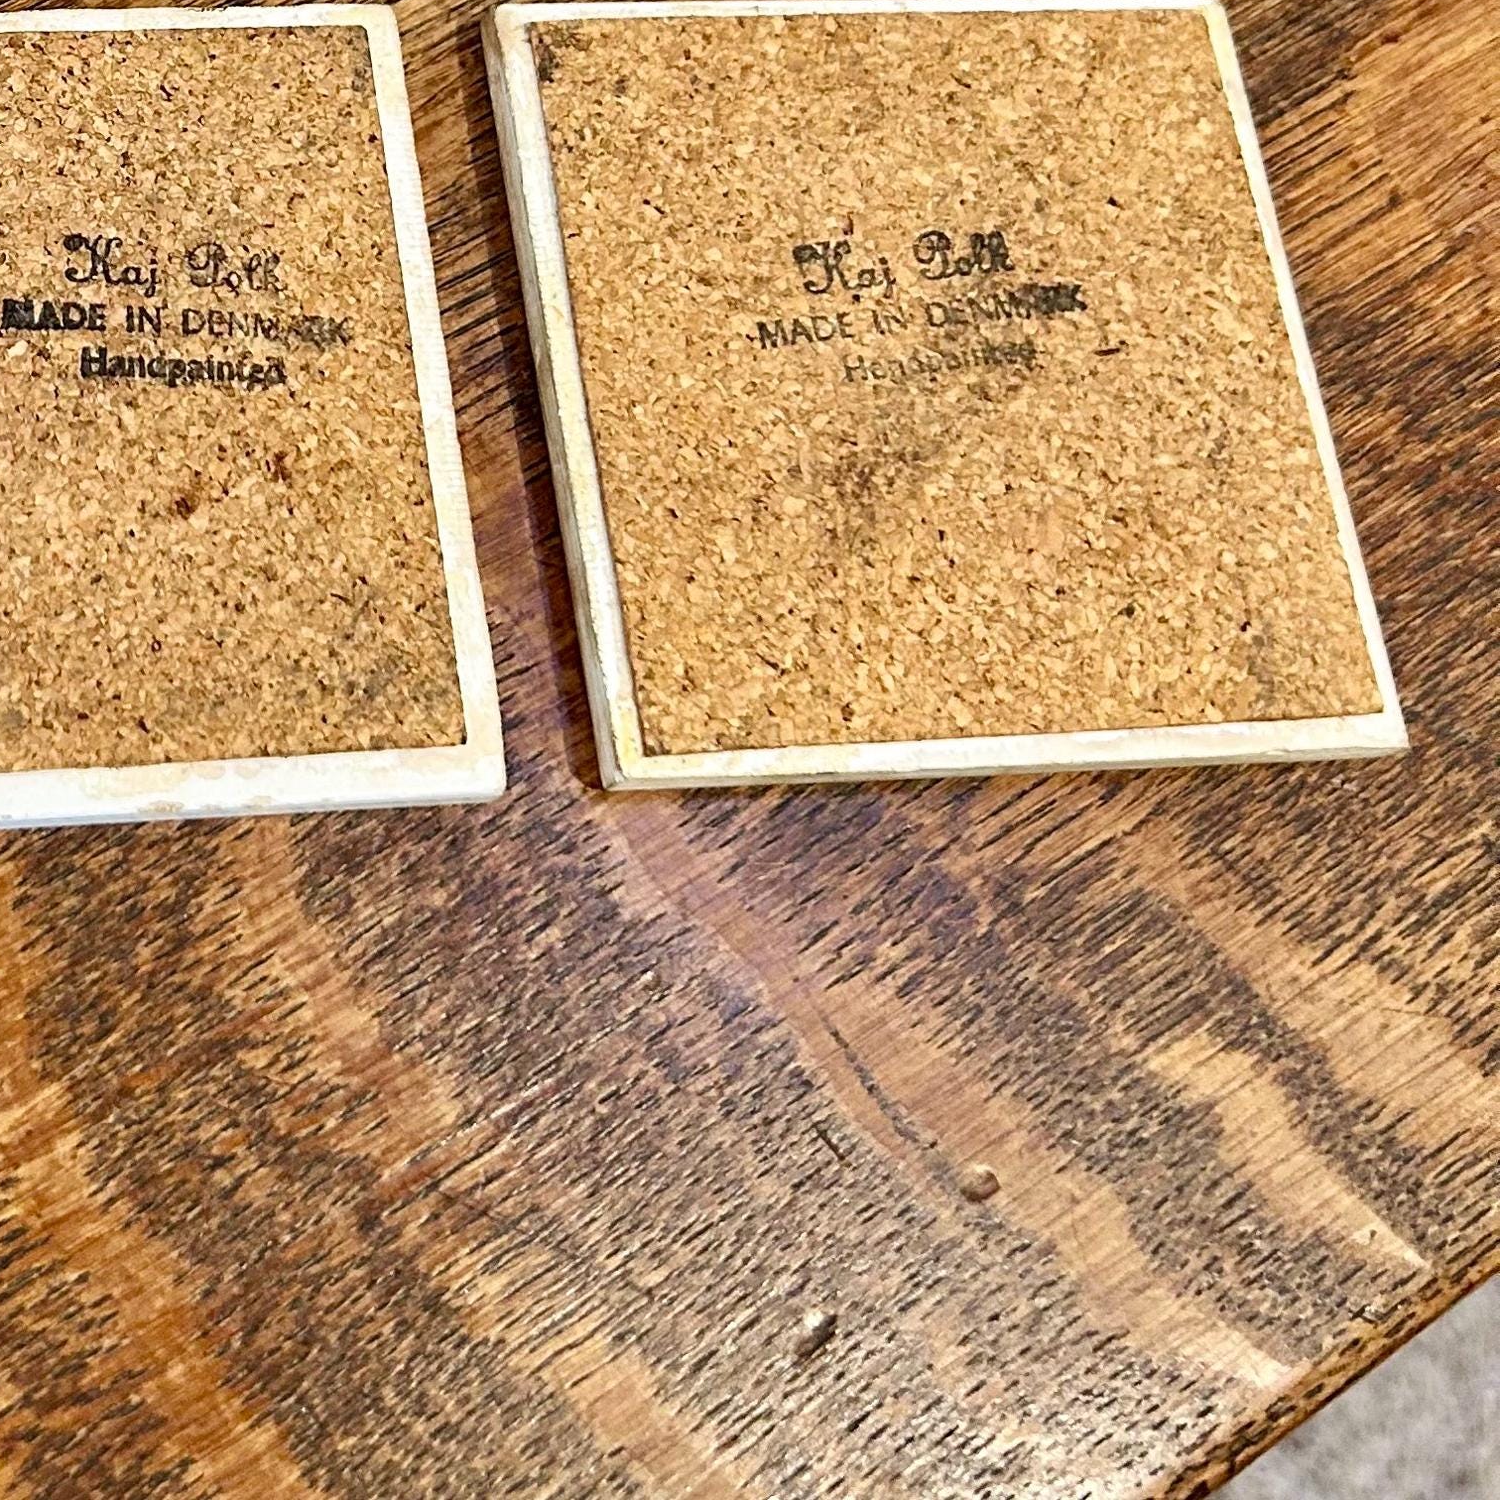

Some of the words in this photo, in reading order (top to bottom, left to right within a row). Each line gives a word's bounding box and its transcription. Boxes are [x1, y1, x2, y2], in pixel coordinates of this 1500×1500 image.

[63, 233, 161, 297] Kaj
[187, 242, 287, 292] Polk
[792, 241, 896, 297] Kaj
[912, 230, 1015, 279] Polk
[0, 299, 107, 331] MADE
[125, 305, 164, 334] IN
[756, 313, 855, 349] MADE
[871, 305, 908, 334] IN
